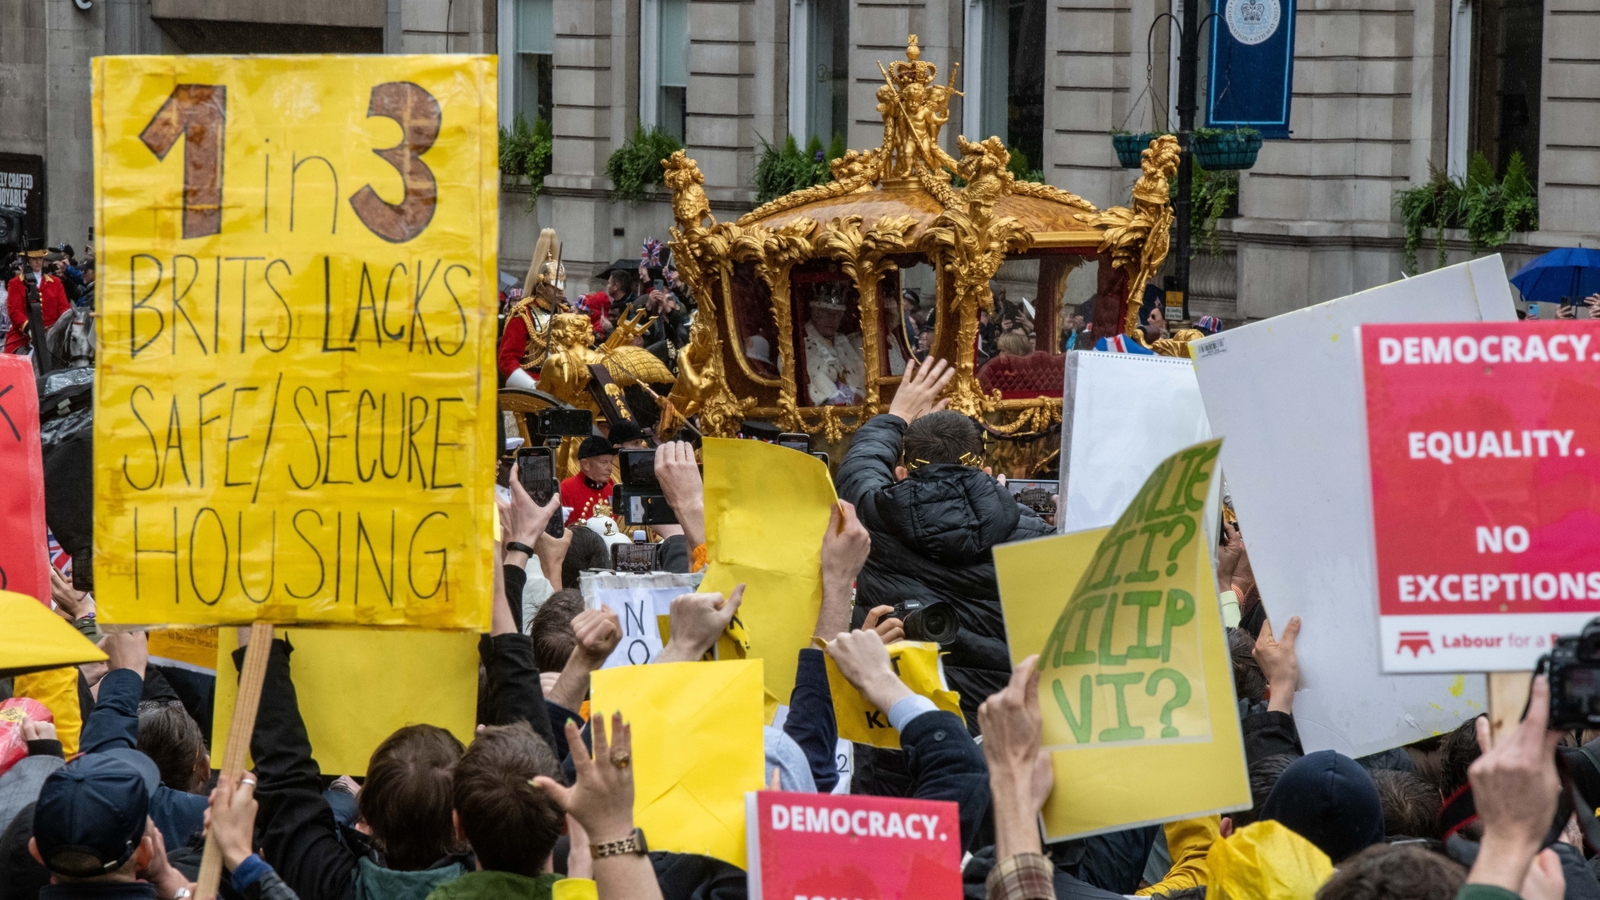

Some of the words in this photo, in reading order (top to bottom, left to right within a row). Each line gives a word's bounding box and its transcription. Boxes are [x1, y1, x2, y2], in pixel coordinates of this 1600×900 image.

[139, 84, 227, 239] 1
[264, 138, 339, 234] in
[349, 81, 442, 243] 3
[8, 173, 33, 189] CRAFTED
[131, 254, 293, 358] BRITS
[322, 256, 471, 356] LACKS
[1379, 335, 1600, 365] DEMOCRACY.
[123, 373, 463, 503] SAFE/SECURE
[1408, 430, 1585, 464] EQUALITY.
[134, 507, 449, 606] HOUSING
[1476, 525, 1530, 554] NO
[1398, 571, 1600, 603] EXCEPTIONS
[1441, 633, 1502, 648] Labour
[1508, 633, 1530, 647] for
[1536, 636, 1545, 647] a
[1052, 668, 1191, 743] VI?
[771, 804, 948, 841] DEMOCRACY.
